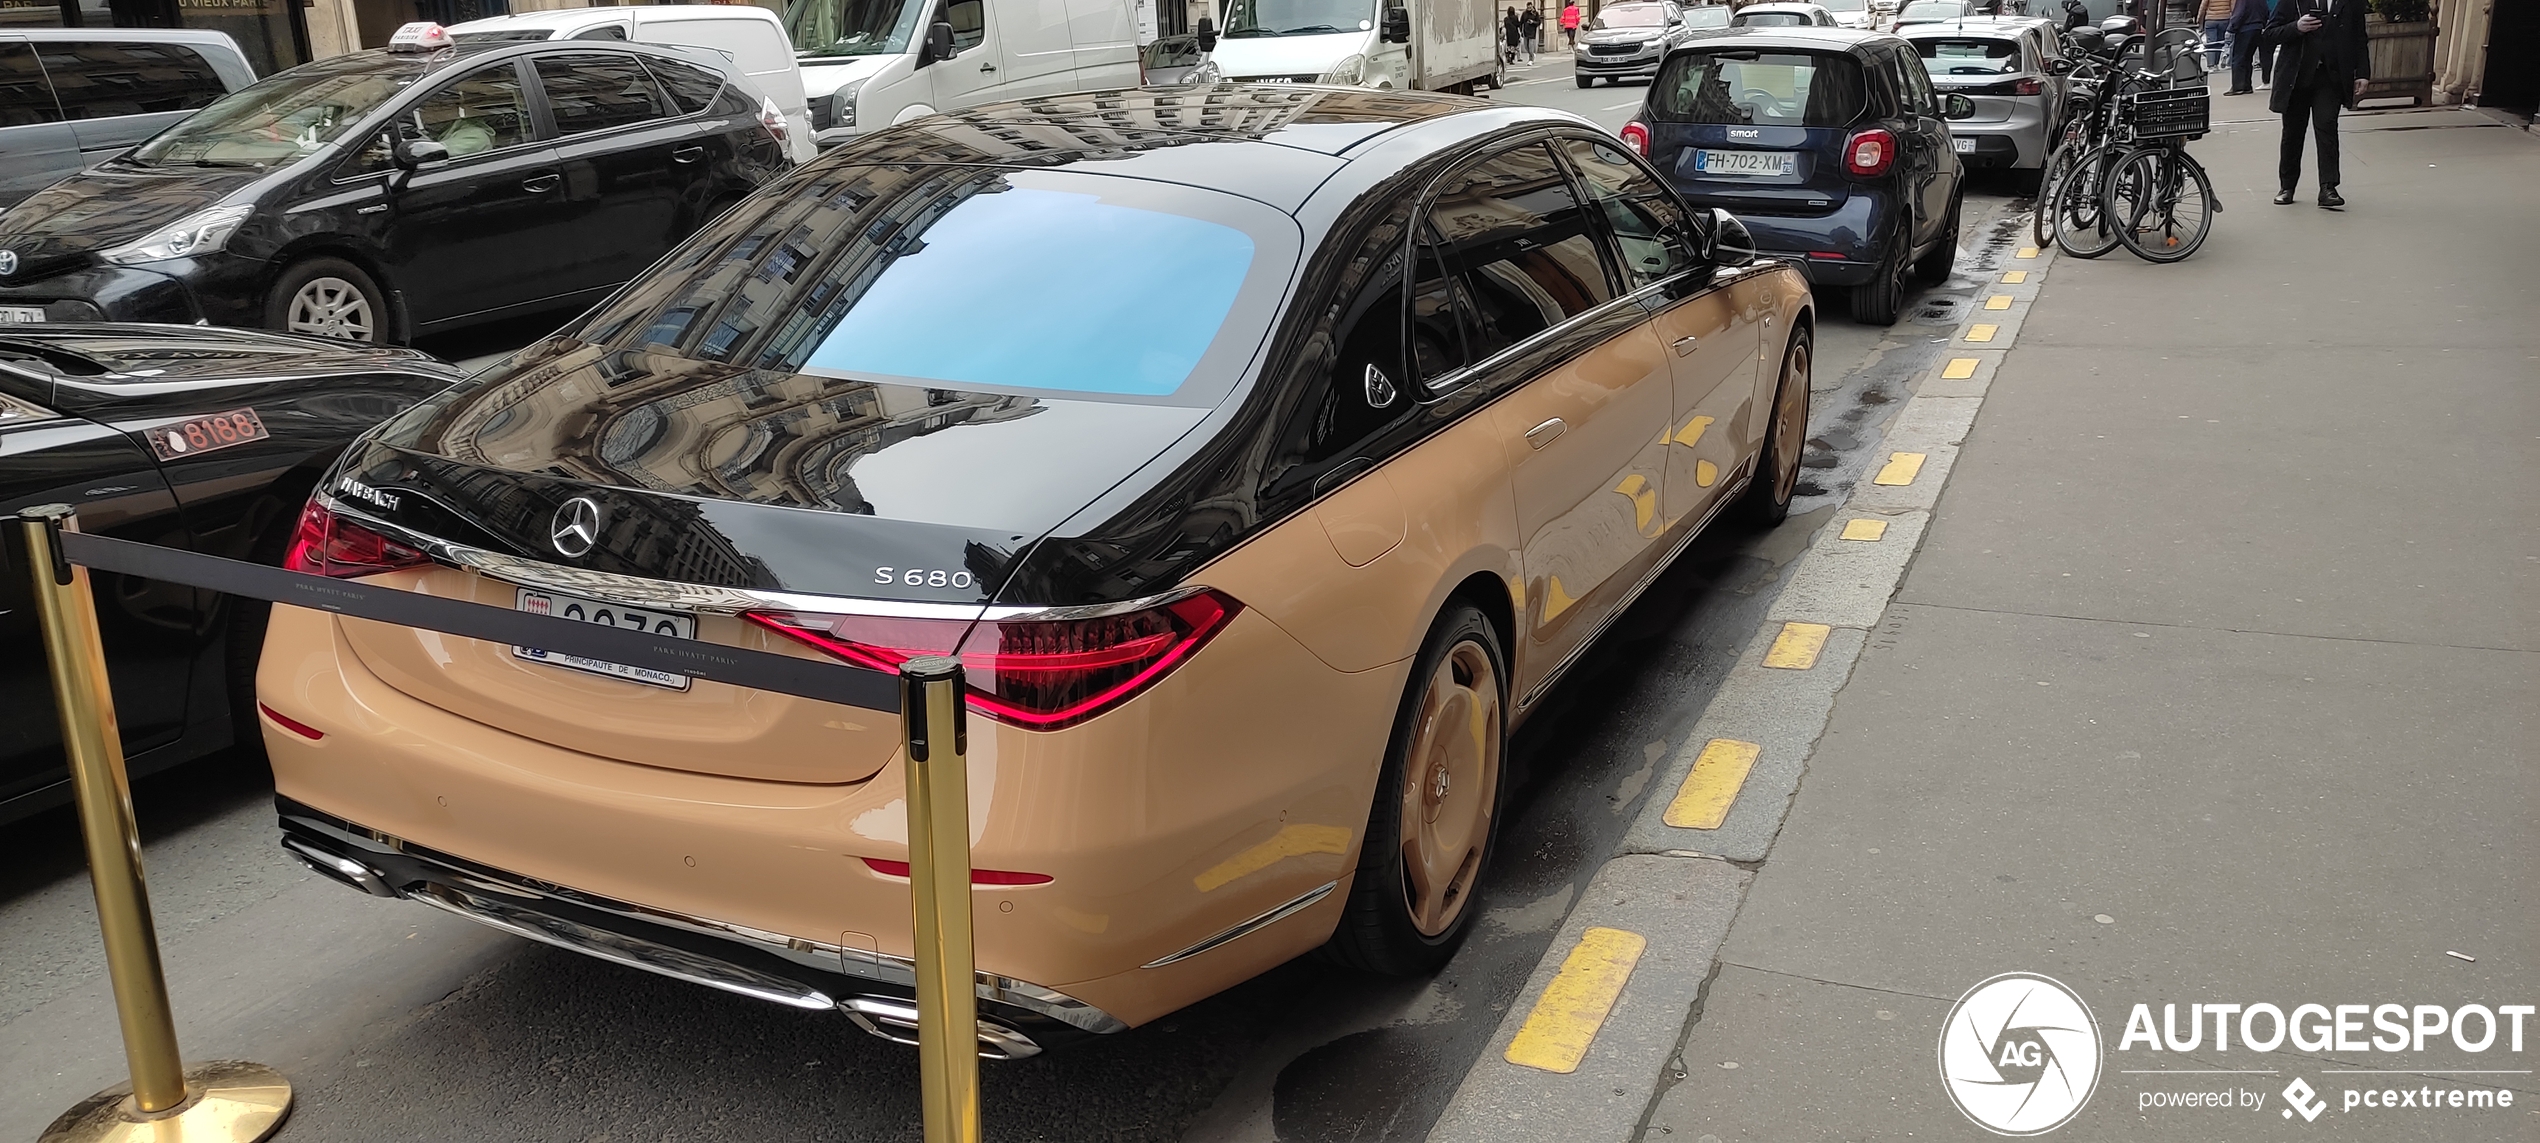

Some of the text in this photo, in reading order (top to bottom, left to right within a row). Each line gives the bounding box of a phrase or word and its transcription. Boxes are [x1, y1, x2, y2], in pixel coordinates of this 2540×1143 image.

[1730, 129, 1759, 139] smart
[1706, 153, 1782, 171] FH-702-XM
[1783, 164, 1792, 173] 75
[184, 413, 256, 449] 8188
[874, 566, 972, 589] S 680
[295, 583, 314, 591] PARK
[316, 587, 340, 596] HYATT
[653, 645, 675, 655] PARK
[678, 650, 706, 661] HYATT
[564, 655, 613, 671] PRINCIPAUTE
[618, 665, 629, 674] DE
